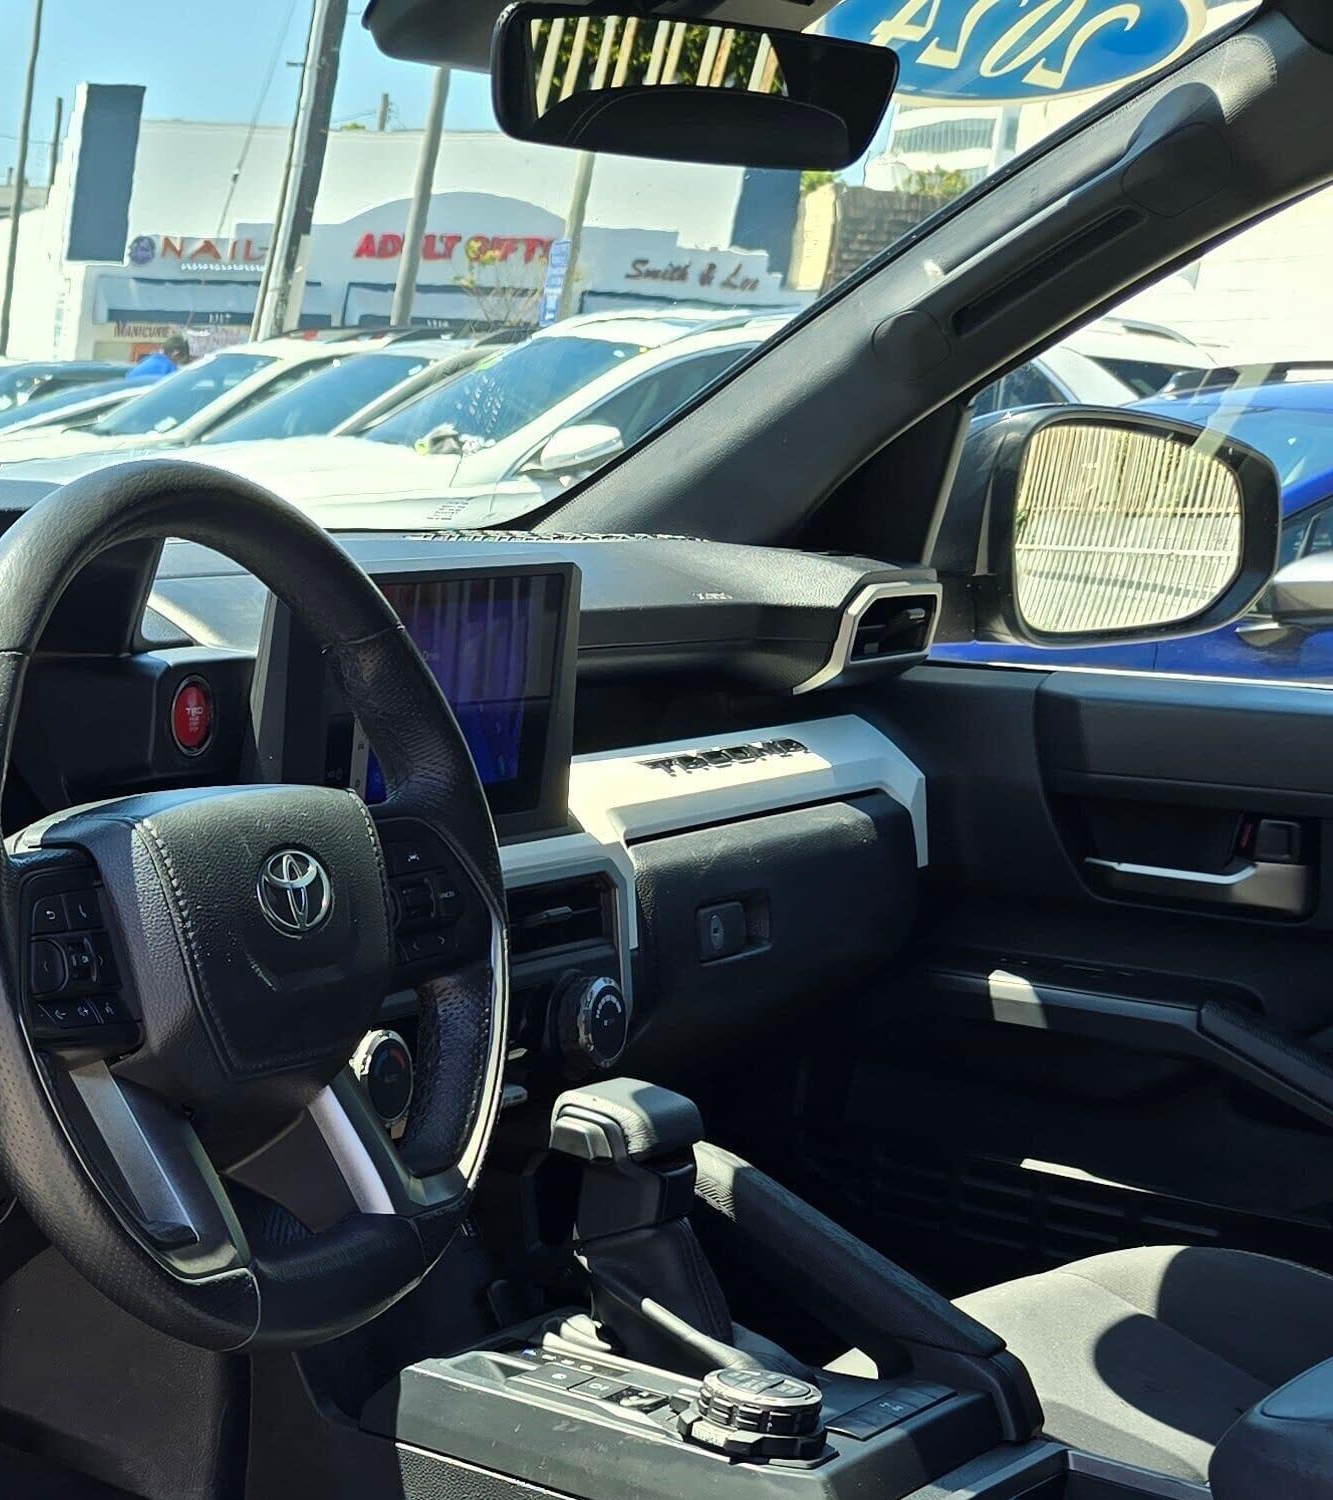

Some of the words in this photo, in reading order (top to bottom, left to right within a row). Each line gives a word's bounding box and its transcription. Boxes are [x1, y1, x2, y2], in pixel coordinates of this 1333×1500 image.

[161, 236, 268, 261] NAIL
[353, 233, 463, 260] ADLT
[465, 235, 550, 264] GIFT
[624, 258, 692, 281] Smith
[699, 262, 717, 287] &
